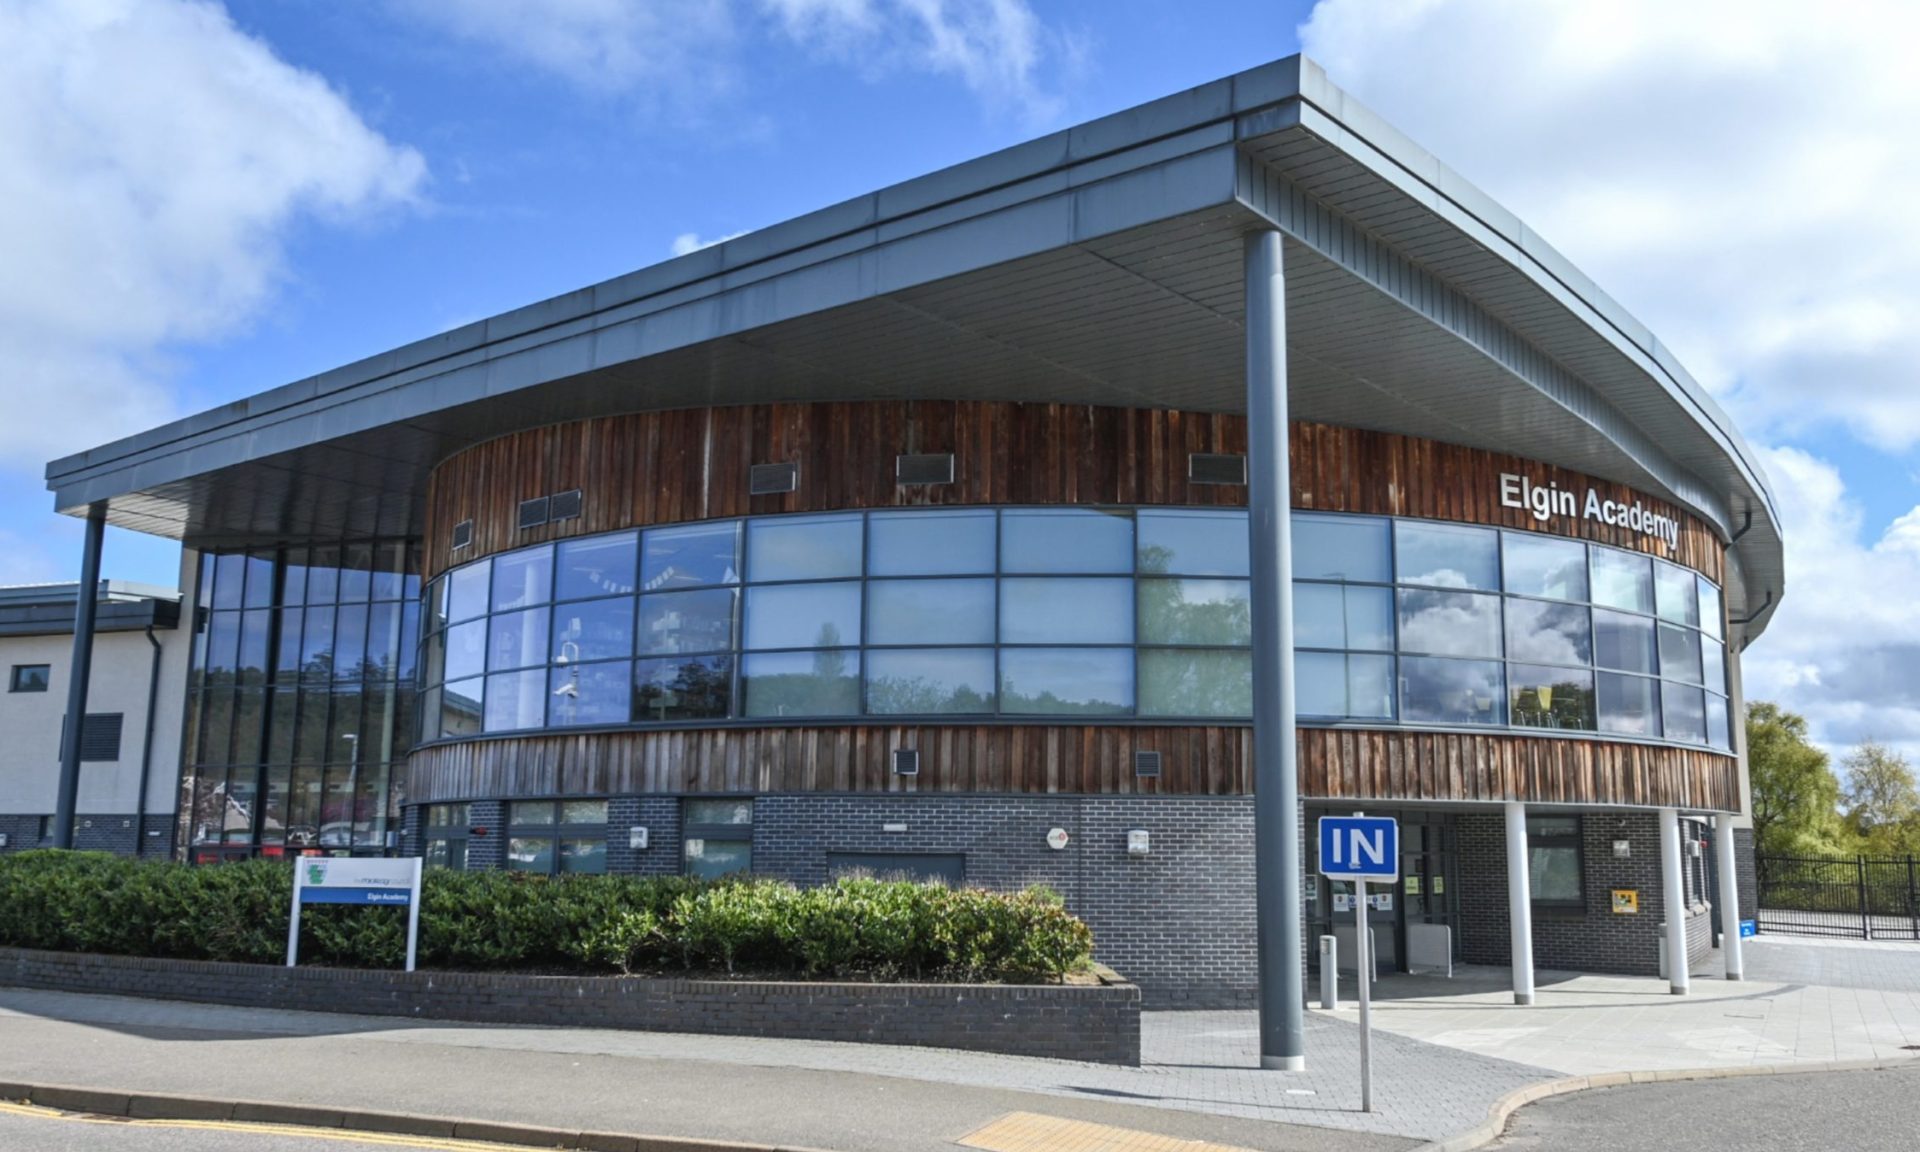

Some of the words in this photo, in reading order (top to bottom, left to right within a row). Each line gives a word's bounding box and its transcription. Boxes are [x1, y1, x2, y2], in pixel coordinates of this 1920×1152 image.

[1500, 473, 1576, 521] Elgin
[1583, 488, 1679, 549] Academy
[1333, 828, 1384, 865] IN
[367, 892, 382, 902] Elgin
[382, 892, 409, 902] Academy
